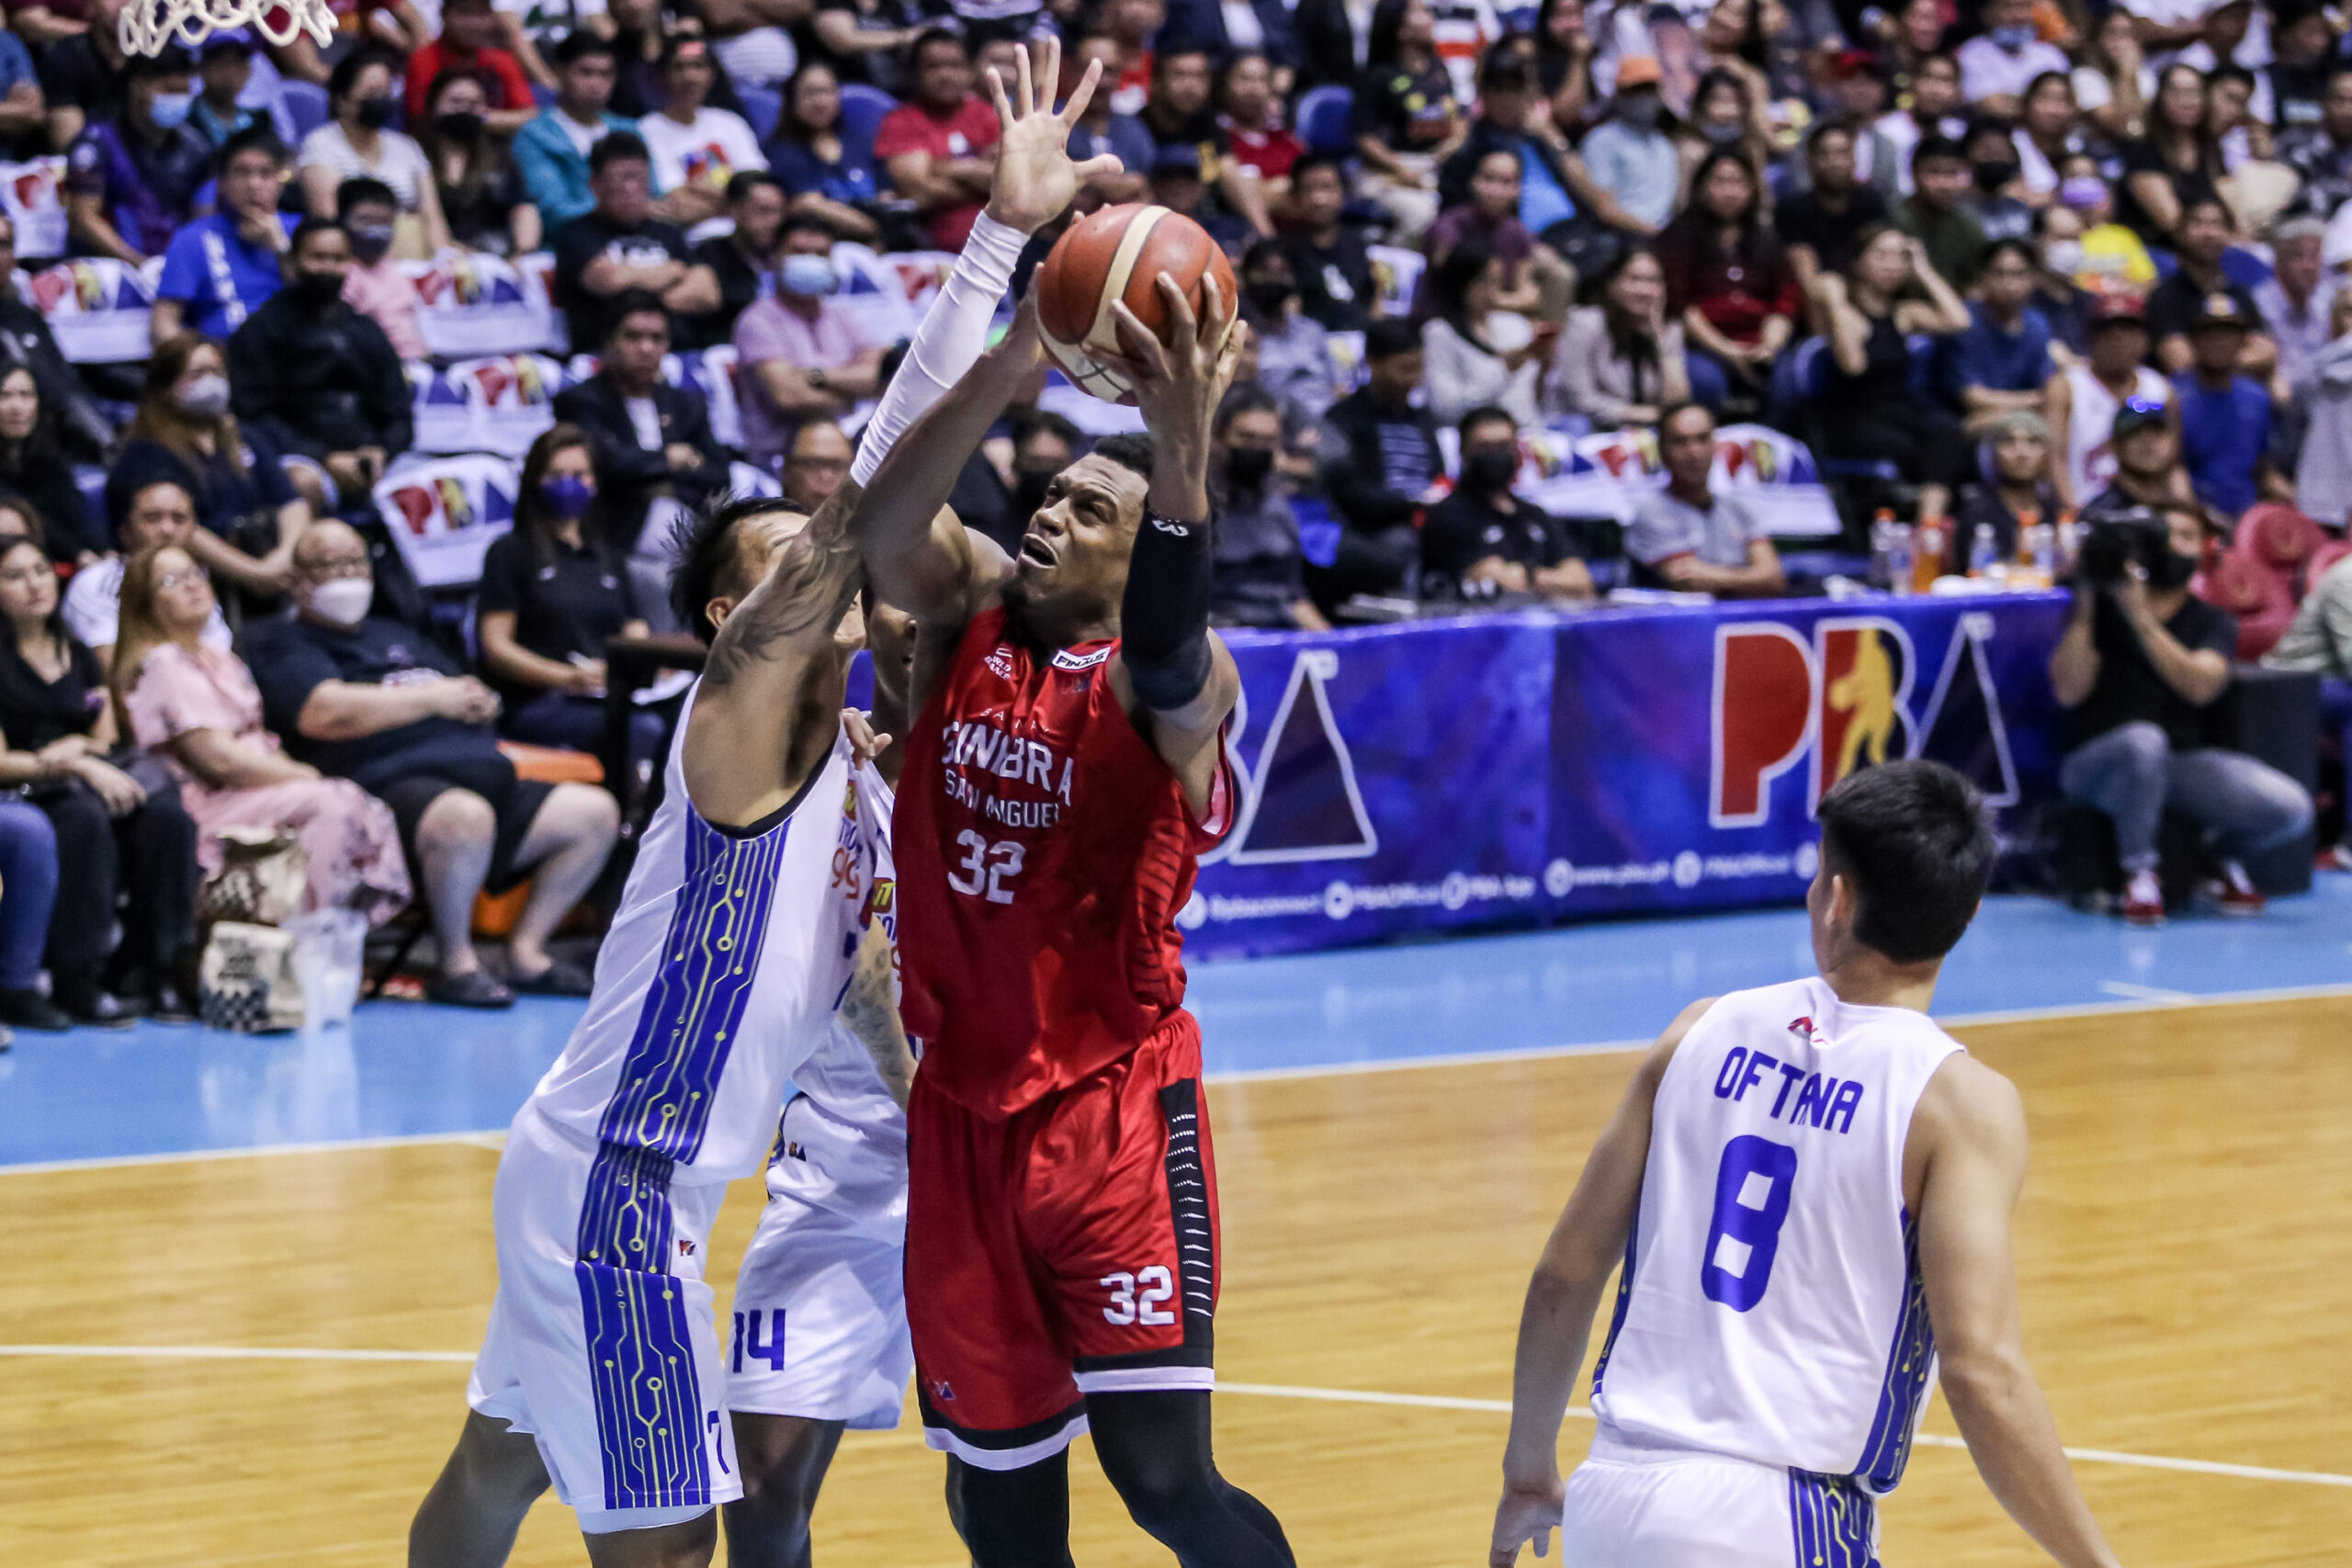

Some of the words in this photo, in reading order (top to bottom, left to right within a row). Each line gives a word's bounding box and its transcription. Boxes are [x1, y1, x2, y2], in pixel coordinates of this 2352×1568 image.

[1709, 613, 2019, 829] PBA
[947, 829, 1027, 905] 32
[1714, 1046, 1864, 1134] OFTANA
[1702, 1134, 1797, 1313] 8
[1100, 1265, 1175, 1325] 32
[733, 1308, 786, 1373] 14
[707, 1410, 730, 1475] 7
